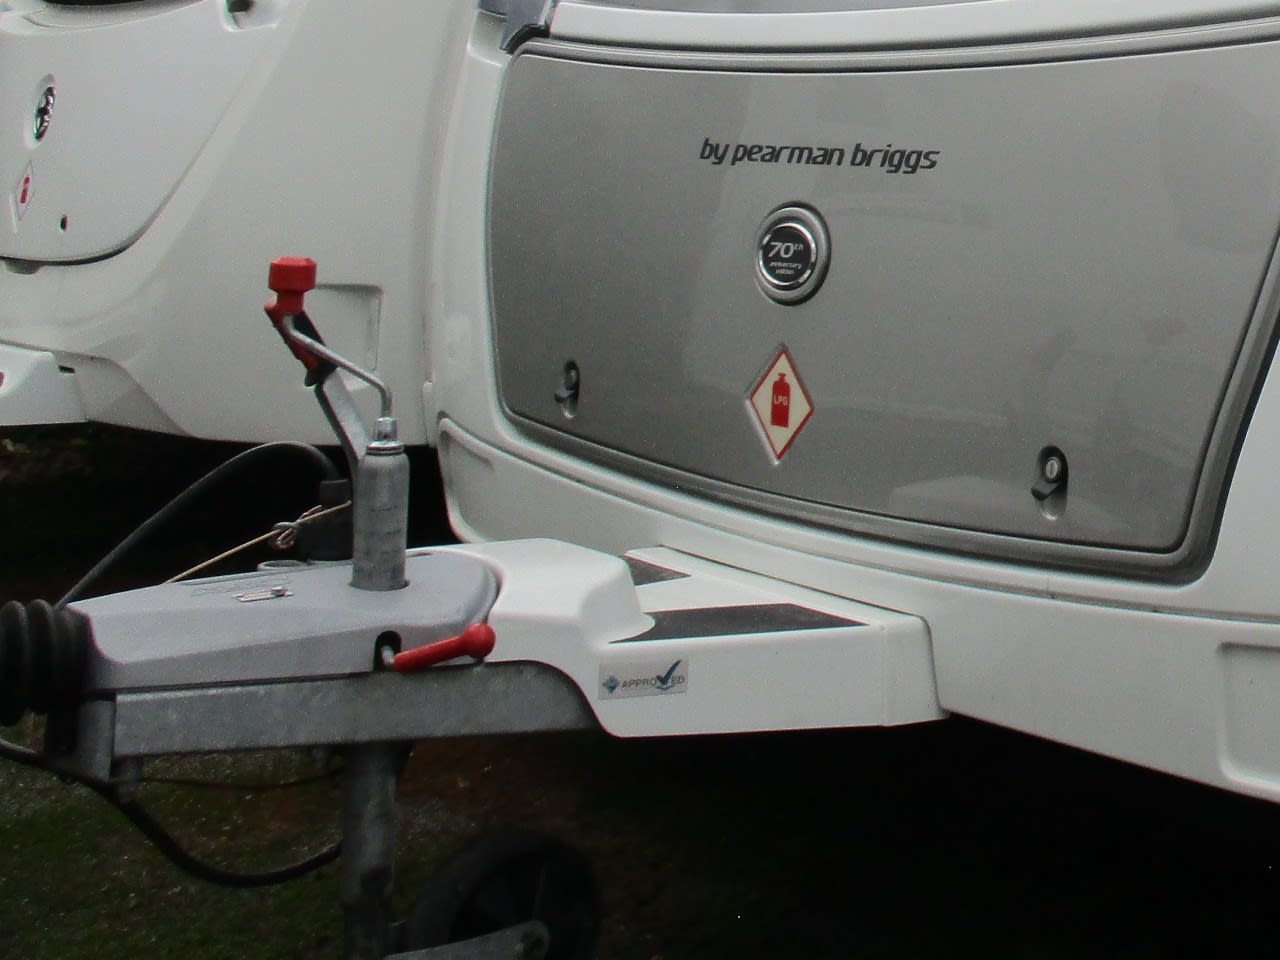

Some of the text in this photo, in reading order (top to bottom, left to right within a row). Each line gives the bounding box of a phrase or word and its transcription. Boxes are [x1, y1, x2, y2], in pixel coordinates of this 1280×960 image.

[700, 138, 940, 174] by pearman briggs
[773, 393, 789, 406] LPG
